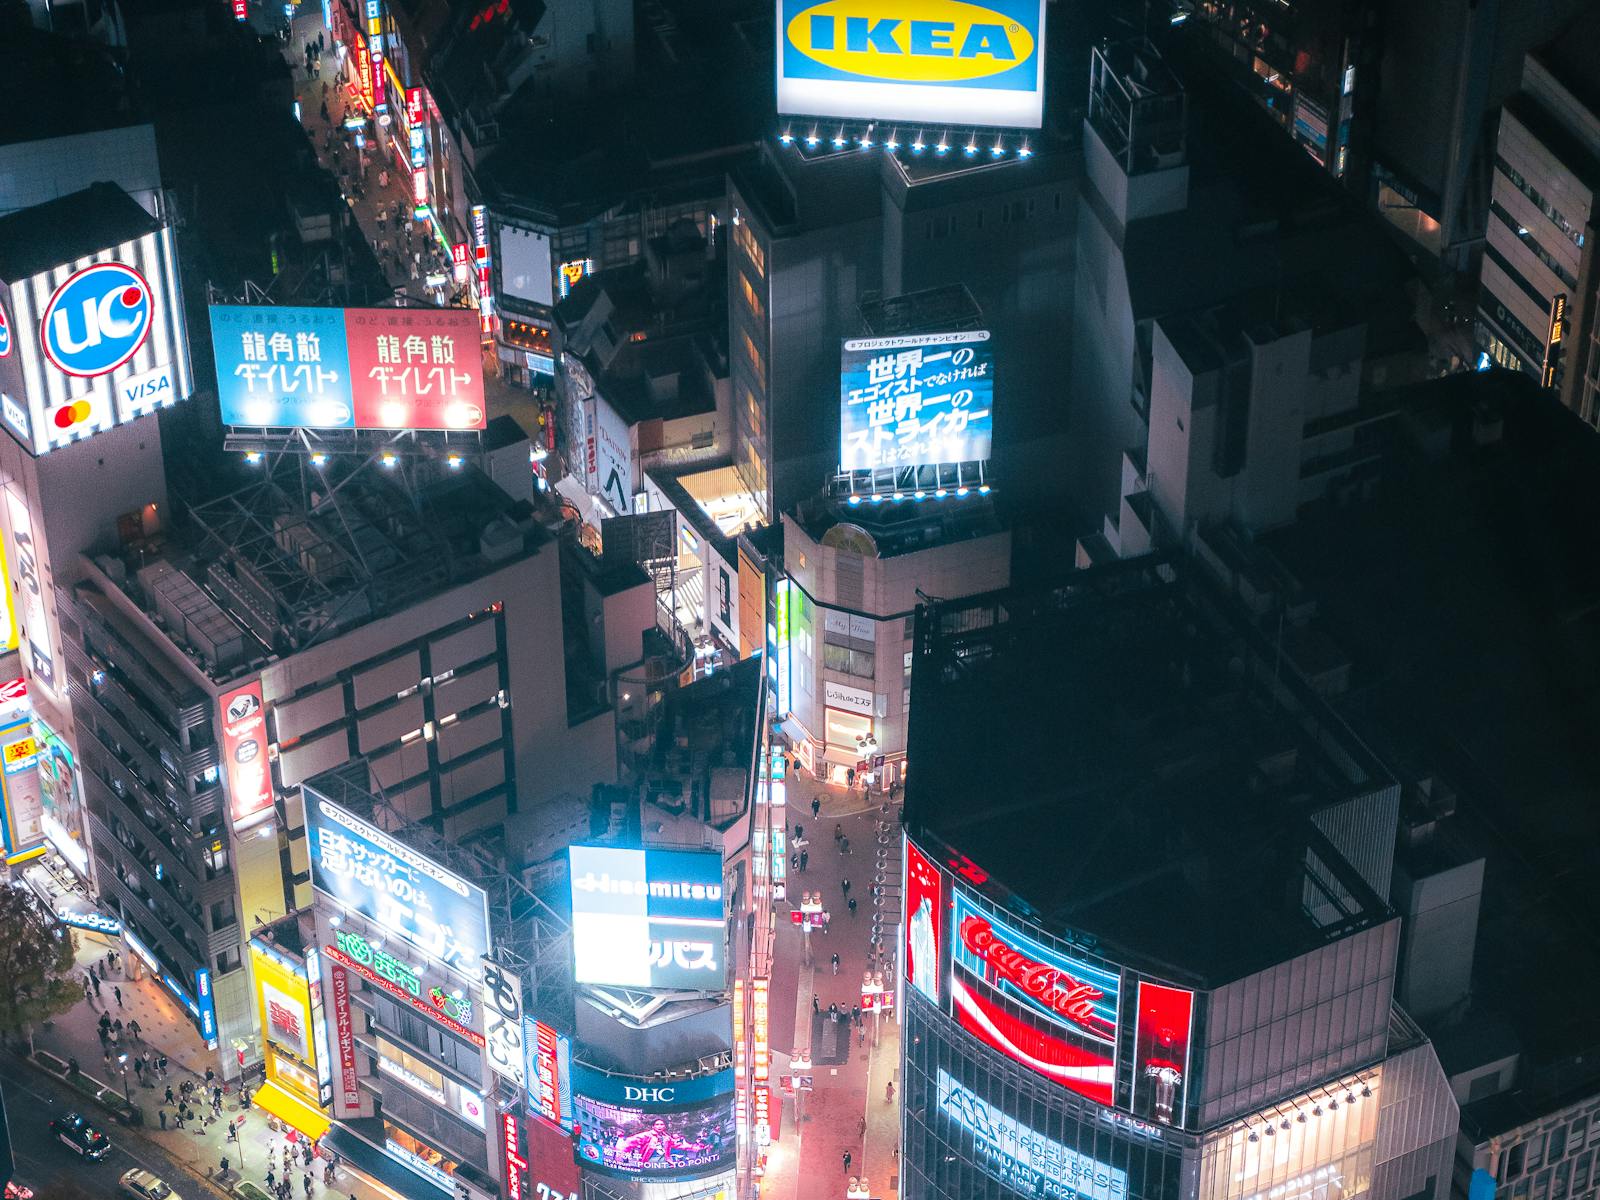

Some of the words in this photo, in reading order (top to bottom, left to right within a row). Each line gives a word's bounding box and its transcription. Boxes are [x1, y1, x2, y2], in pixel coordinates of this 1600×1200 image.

[809, 14, 1016, 61] IKEA
[54, 284, 143, 354] UC
[241, 331, 322, 363] 龍角散
[376, 334, 456, 365] 龍角散
[234, 363, 339, 394] ダイレクト
[368, 366, 472, 396] ダイレクト
[867, 347, 975, 385] 世界一の
[126, 375, 170, 402] VISA
[848, 363, 988, 405] エゴイストでなければ
[866, 389, 974, 427] 世界一の
[847, 408, 989, 451] ストライカー
[34, 651, 51, 677] 7F
[318, 827, 421, 883] 日本サッカーに
[960, 915, 1104, 1018] Coca-Cola
[623, 1086, 675, 1102] DHC
[673, 1160, 686, 1169] TO
